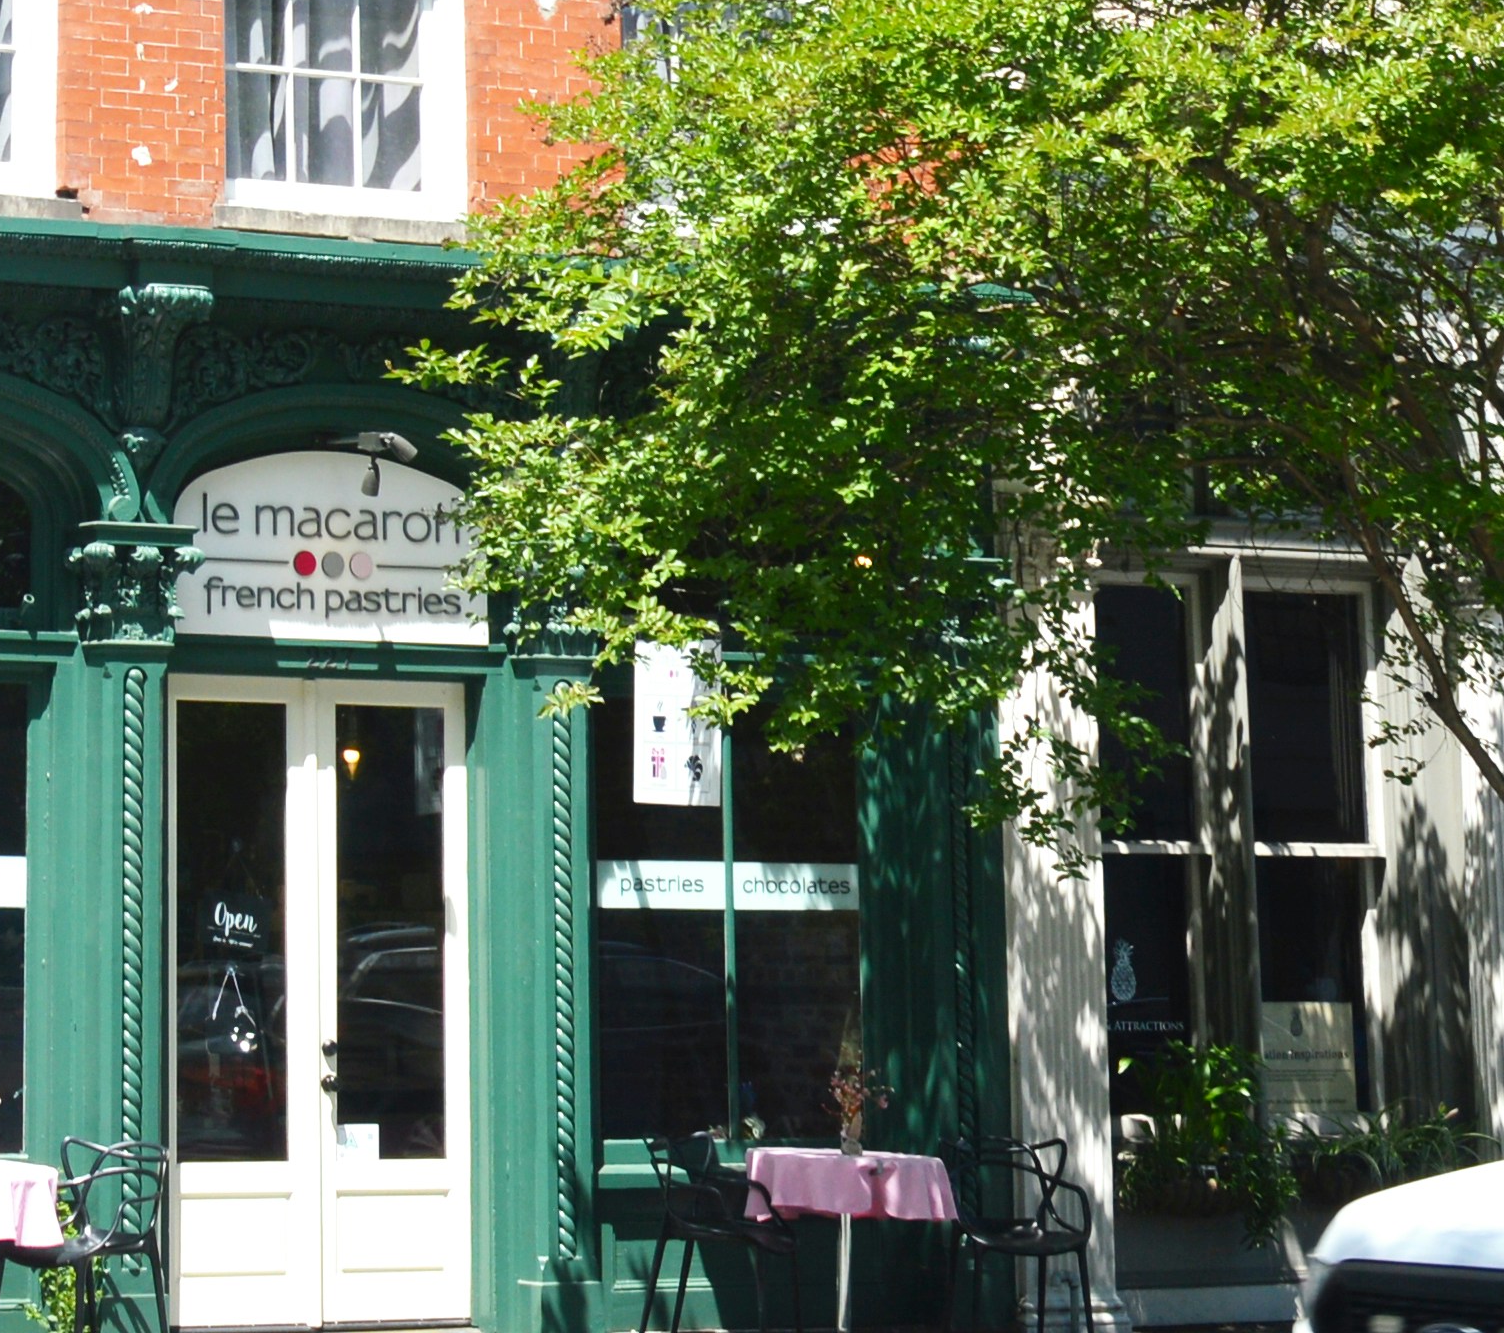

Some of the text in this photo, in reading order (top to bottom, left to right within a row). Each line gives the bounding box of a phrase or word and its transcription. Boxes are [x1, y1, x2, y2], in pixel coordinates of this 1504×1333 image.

[202, 492, 461, 545] le macaron
[204, 576, 462, 619] french pastries
[620, 875, 705, 896] pastries
[743, 877, 851, 896] chocolates
[214, 901, 258, 937] Open
